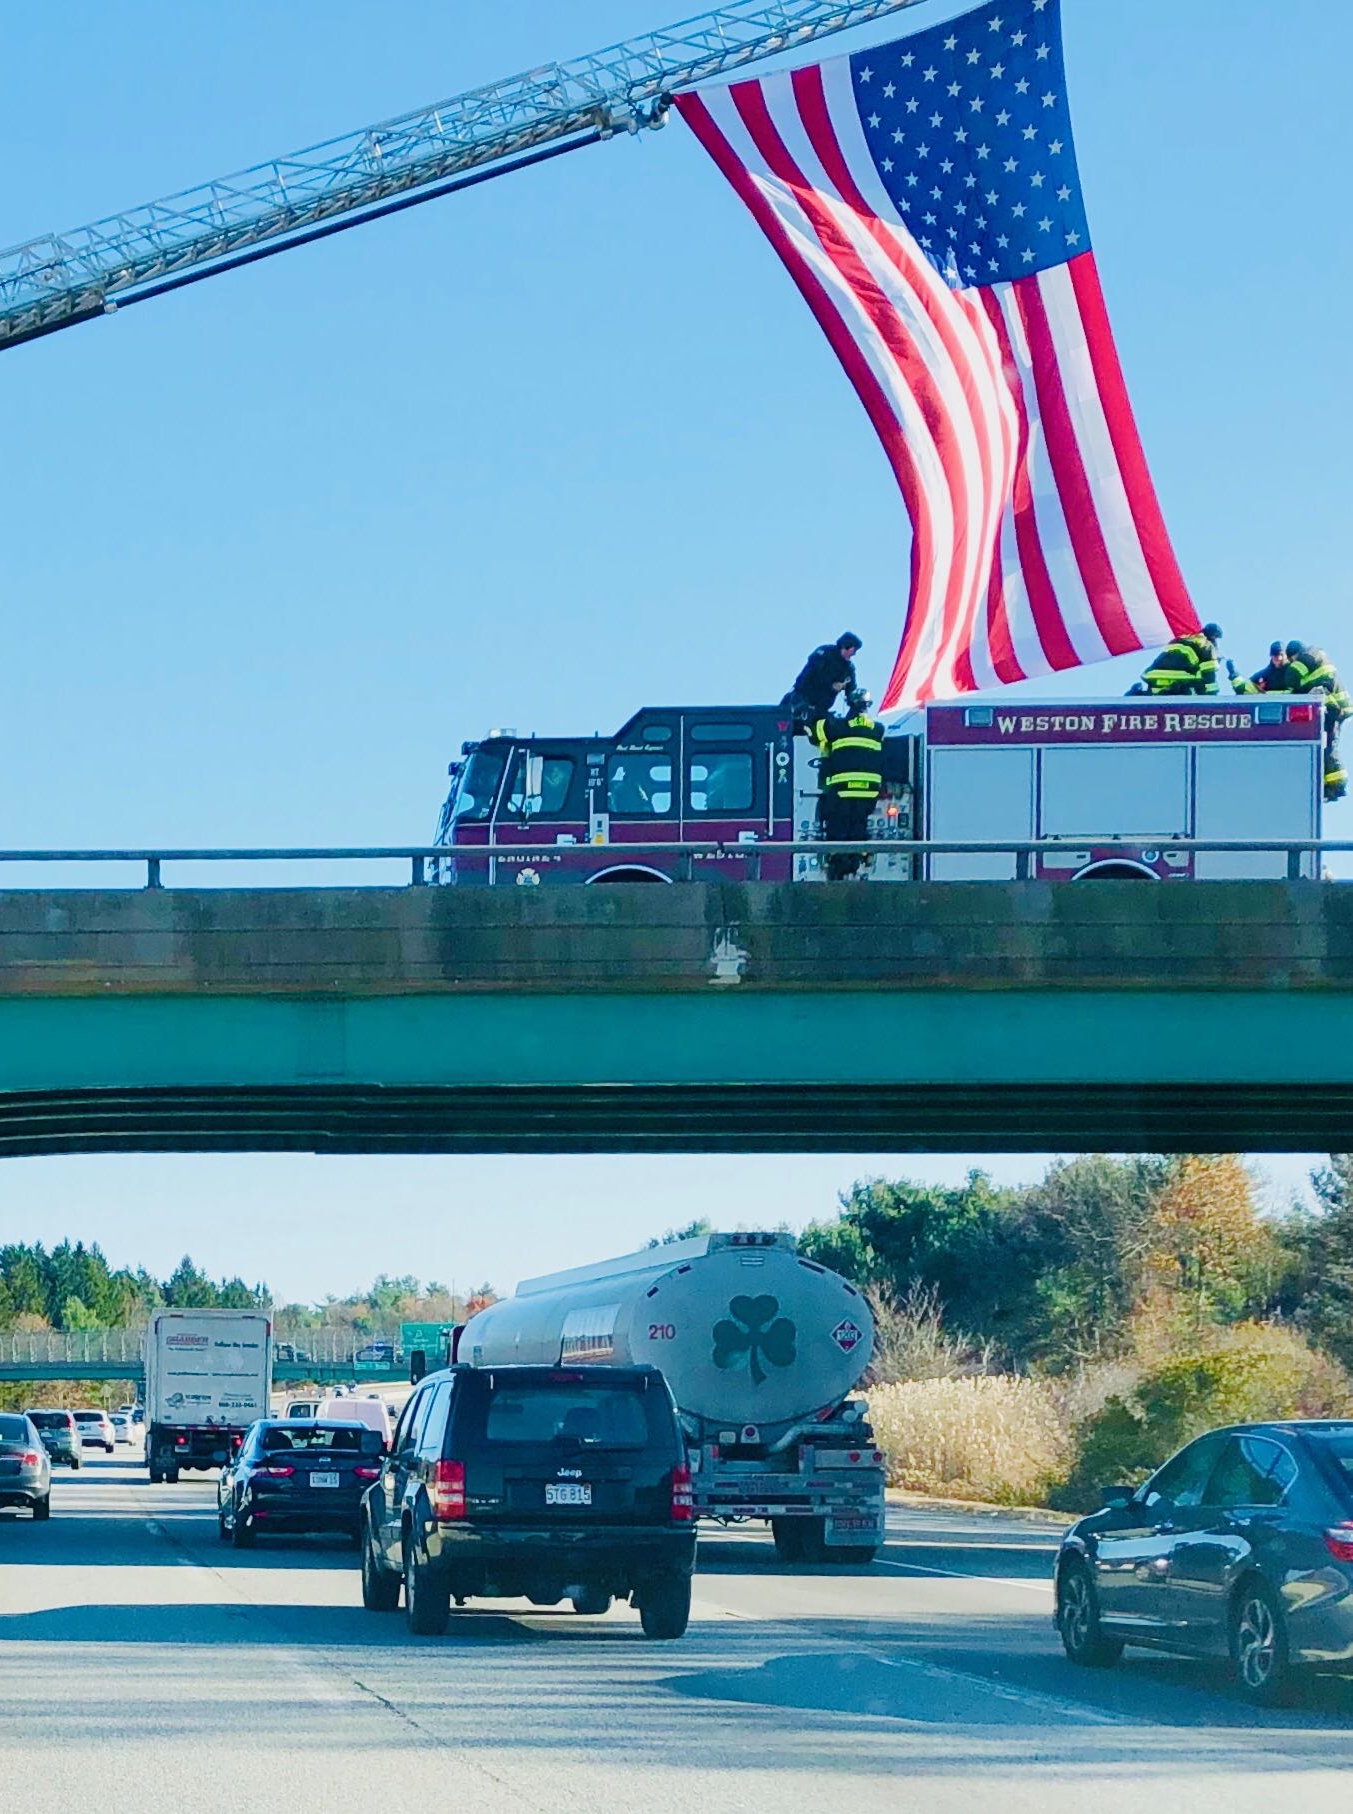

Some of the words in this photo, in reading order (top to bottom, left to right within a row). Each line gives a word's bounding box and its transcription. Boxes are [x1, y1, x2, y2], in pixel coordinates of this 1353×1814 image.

[997, 714, 1095, 735] WESTON
[1101, 713, 1158, 733] FIRE
[1164, 712, 1252, 732] RESCUE
[649, 1324, 676, 1340] 210
[557, 1467, 582, 1479] Jeep
[570, 1488, 591, 1501] 815
